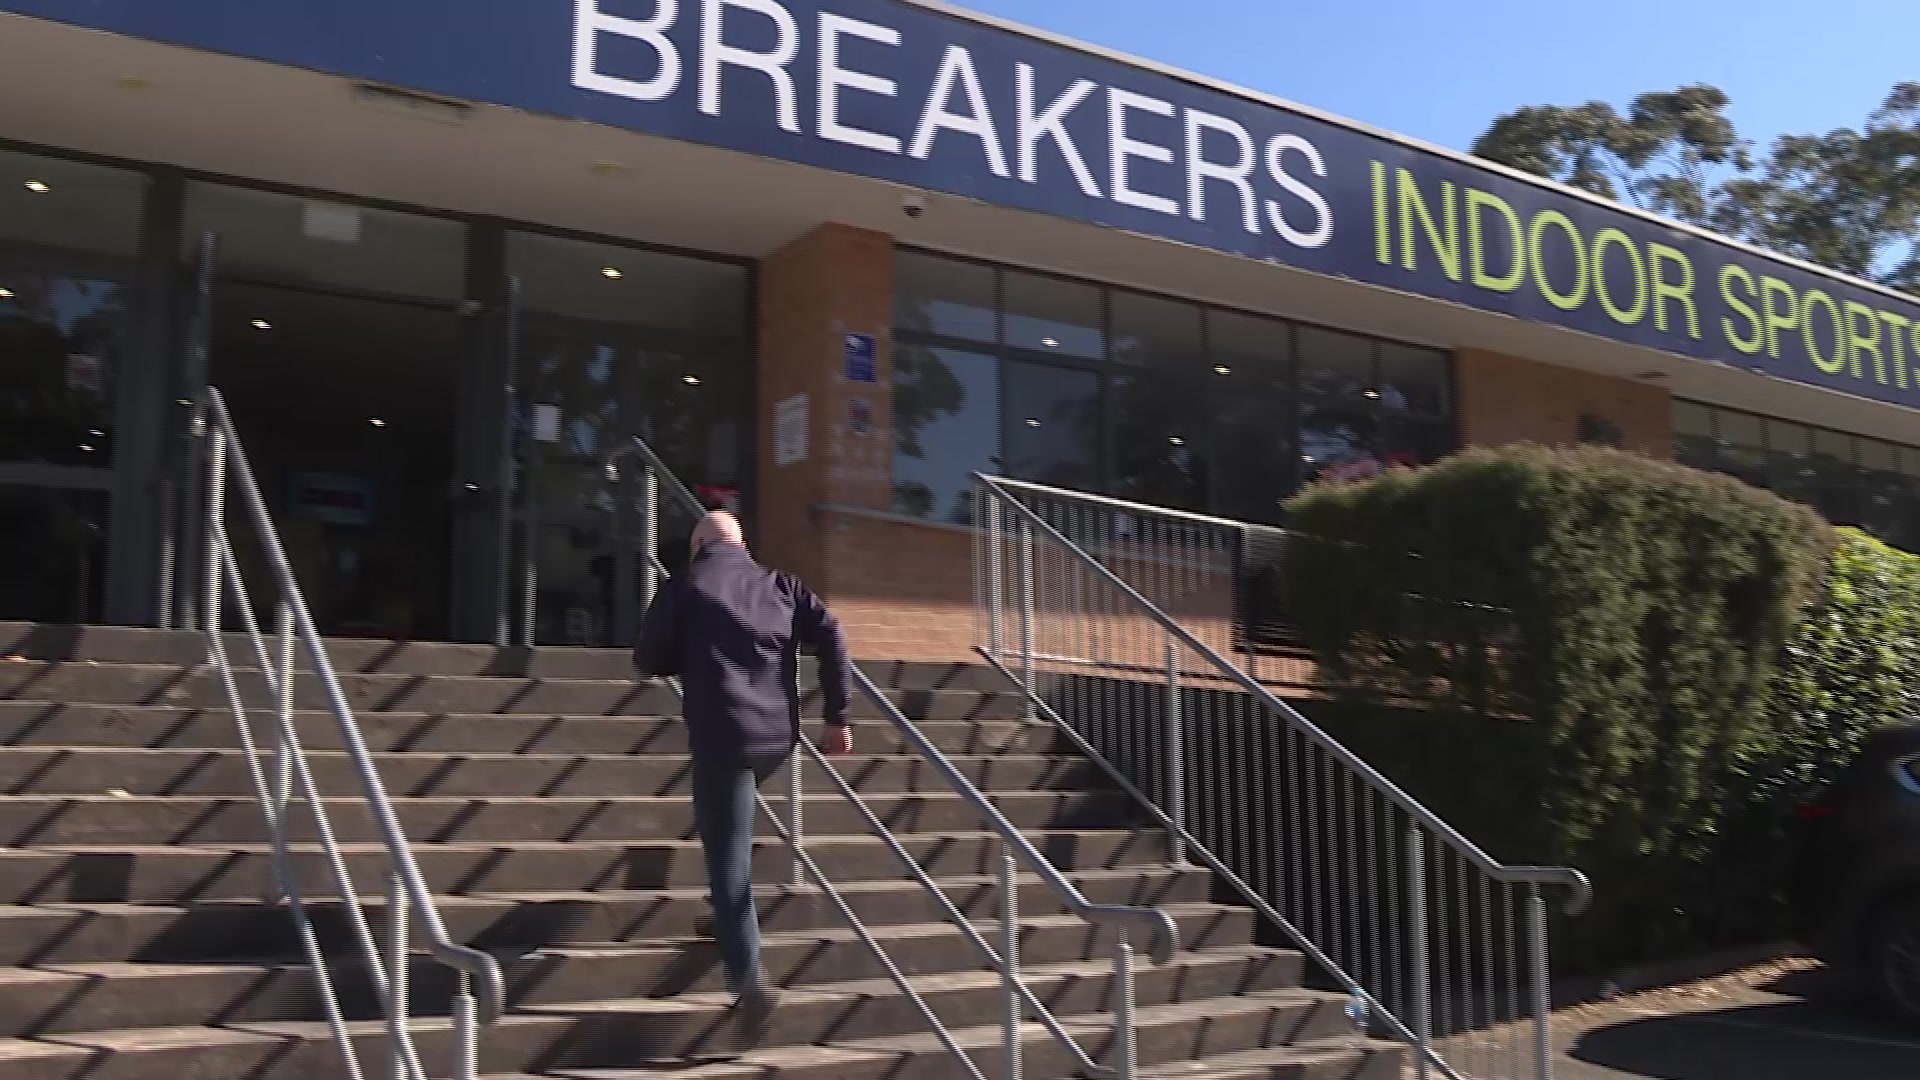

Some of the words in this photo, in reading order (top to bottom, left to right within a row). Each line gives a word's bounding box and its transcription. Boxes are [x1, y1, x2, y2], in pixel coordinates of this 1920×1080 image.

[570, 0, 1334, 249] BREAKERS
[1371, 162, 1701, 339] INDOOR
[1718, 264, 1920, 389] SPORT
